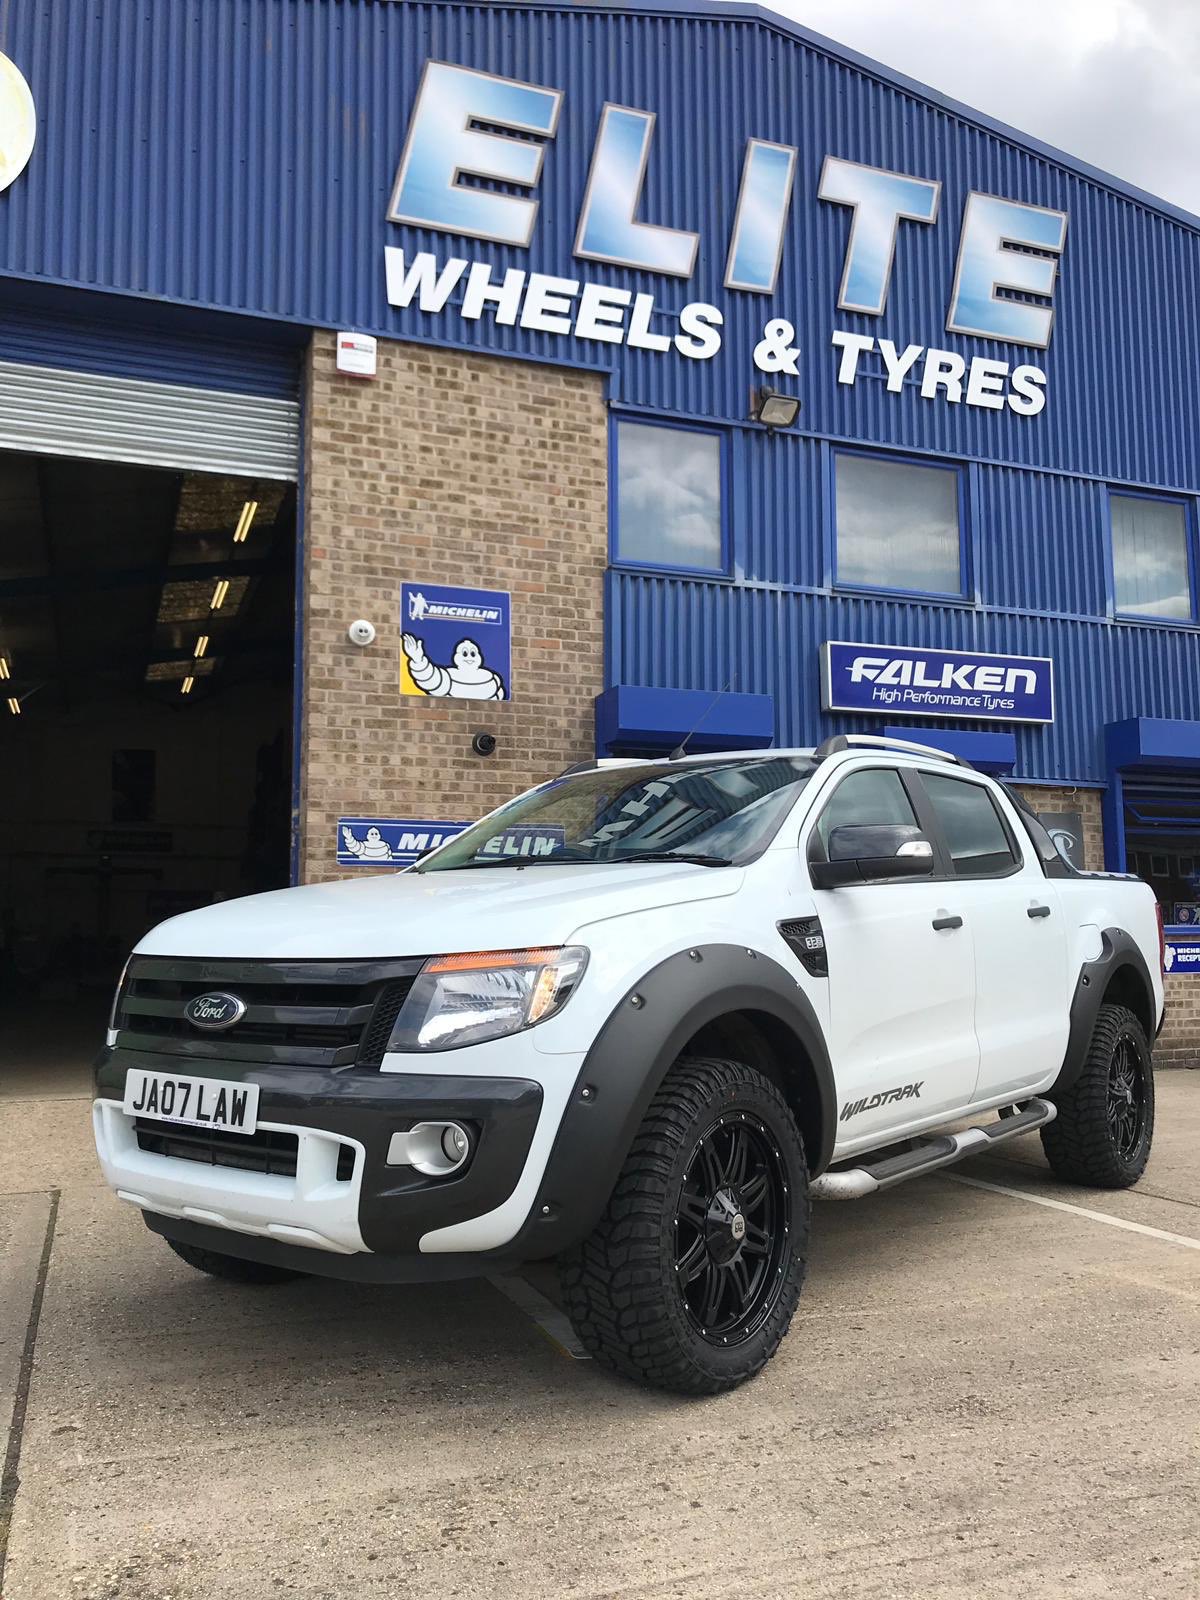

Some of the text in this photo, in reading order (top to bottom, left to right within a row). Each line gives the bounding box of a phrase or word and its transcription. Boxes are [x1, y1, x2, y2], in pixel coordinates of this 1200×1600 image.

[385, 59, 1068, 348] ELITE
[384, 245, 1047, 415] WHEELS & TYRES
[428, 605, 499, 619] MICHELIN
[845, 656, 1038, 694] FALKEN
[872, 687, 1015, 709] High Performance Tyres
[397, 833, 555, 856] MIELIN
[193, 997, 226, 1019] Ford
[133, 1077, 248, 1127] JA07 LAW
[840, 1081, 924, 1121] WILDTRAK
